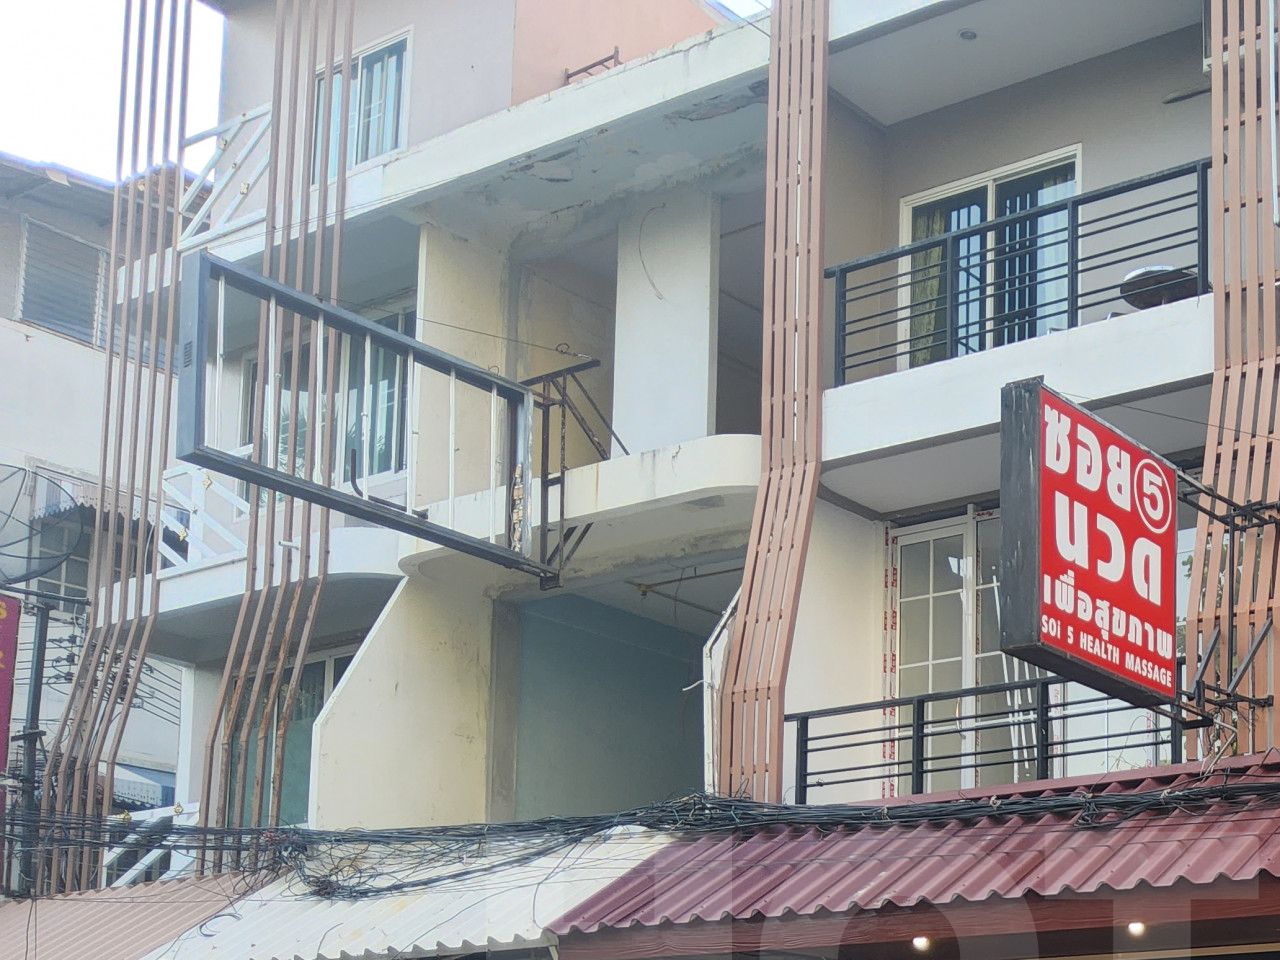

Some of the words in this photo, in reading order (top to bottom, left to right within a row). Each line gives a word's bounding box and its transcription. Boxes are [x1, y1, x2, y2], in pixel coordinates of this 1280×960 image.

[1044, 404, 1131, 513] ซอย
[1055, 490, 1161, 606] นวด
[1043, 569, 1173, 660] เพื่อสุขภาพ
[1067, 625, 1074, 645] 5
[1079, 630, 1120, 665] HEALTH
[1125, 651, 1172, 688] MASSAGE
